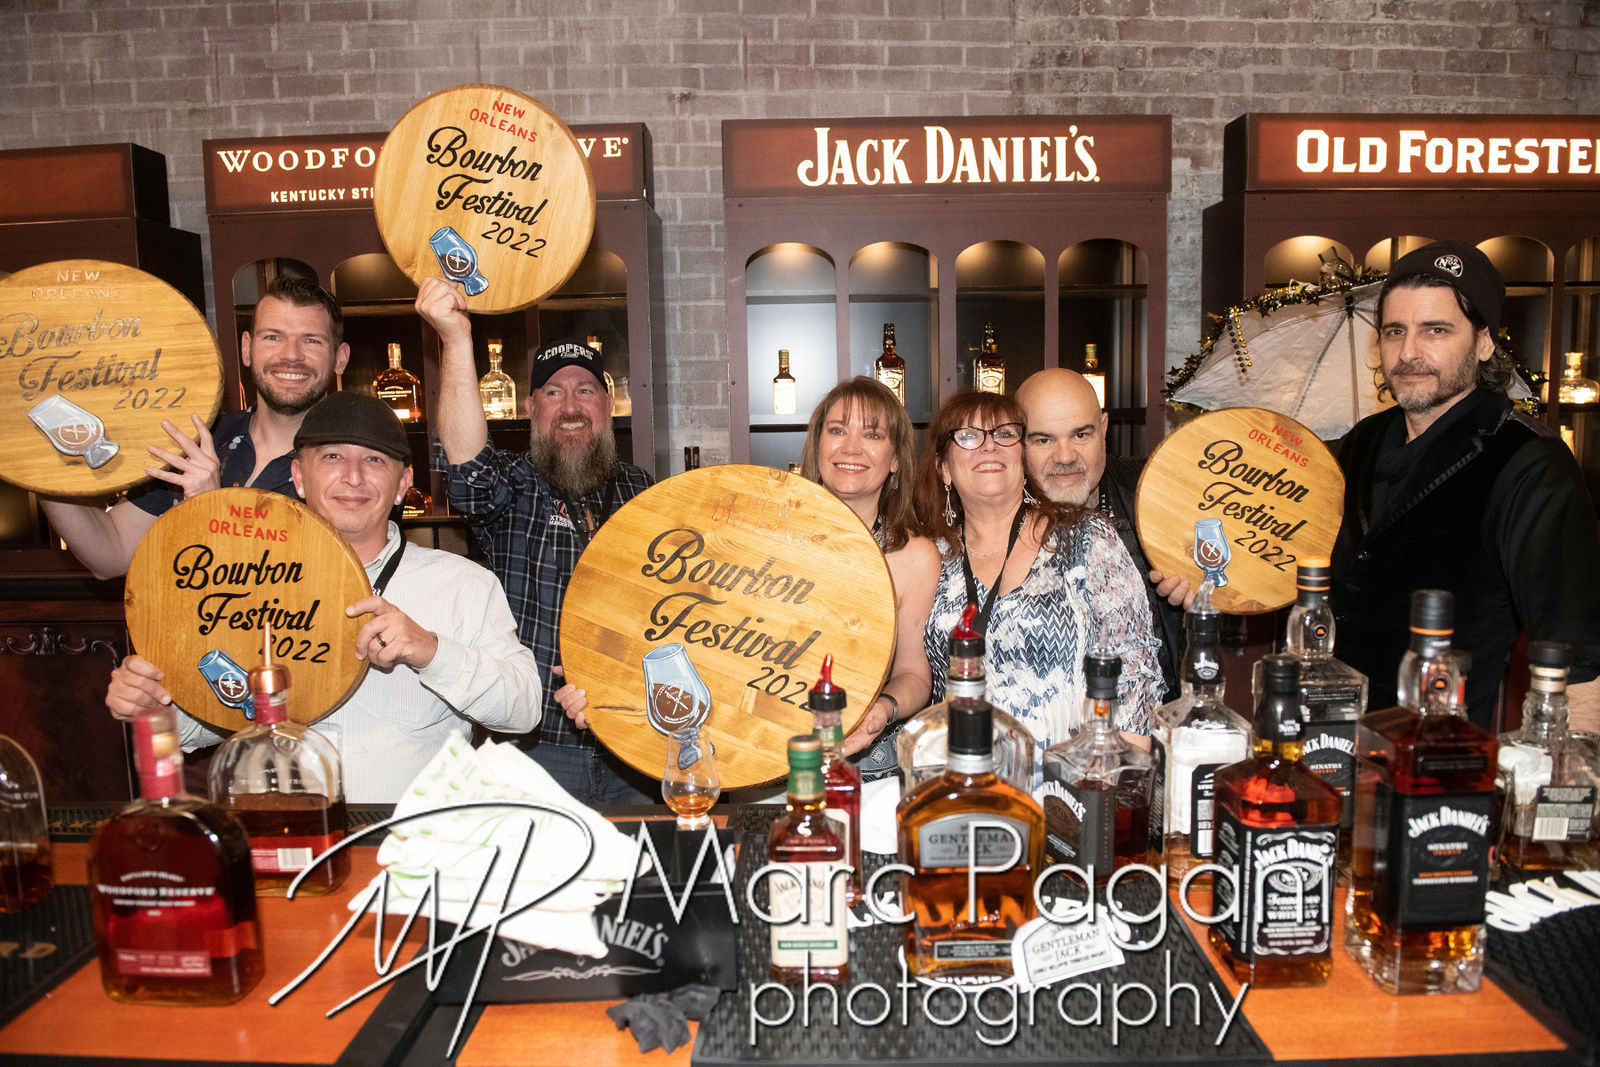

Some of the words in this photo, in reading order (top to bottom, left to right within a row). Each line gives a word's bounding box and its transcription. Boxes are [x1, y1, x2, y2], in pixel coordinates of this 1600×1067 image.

[469, 109, 538, 143] ORLEANS
[491, 99, 527, 119] NEW
[216, 146, 376, 173] WOODFO
[426, 126, 543, 182] Bourbon
[797, 127, 912, 187] JACK
[1296, 129, 1388, 173] OLD
[1398, 130, 1600, 174] FORESTE
[270, 188, 346, 202] KENTUCKY
[435, 174, 548, 226] Festival
[481, 221, 547, 259] 2022
[32, 287, 124, 299] ORLEANS
[56, 269, 101, 282] NEW
[0, 308, 143, 359] Bourbon
[18, 347, 163, 402] Festival
[113, 386, 187, 411] 2022
[1248, 429, 1309, 468] ORLEANS
[1271, 424, 1304, 447] NEW
[1198, 439, 1310, 503] Bourbon
[229, 504, 269, 520] NEW
[746, 496, 797, 519] NEW
[1198, 481, 1308, 542] Festival
[208, 518, 288, 542] ORLEANS
[172, 544, 305, 590] Bourbon
[641, 528, 816, 605] Bourbon
[1234, 530, 1297, 572] 2022
[197, 591, 321, 636] Festival
[644, 591, 822, 671] Festival
[1302, 737, 1320, 756] ACK
[1408, 811, 1440, 838] JACK
[1439, 805, 1490, 837] DANIEL'S
[1253, 843, 1288, 869] JACK
[600, 914, 669, 961] NIEL'S
[1032, 927, 1100, 954] GENTLEMAN
[1055, 948, 1082, 963] JACK
